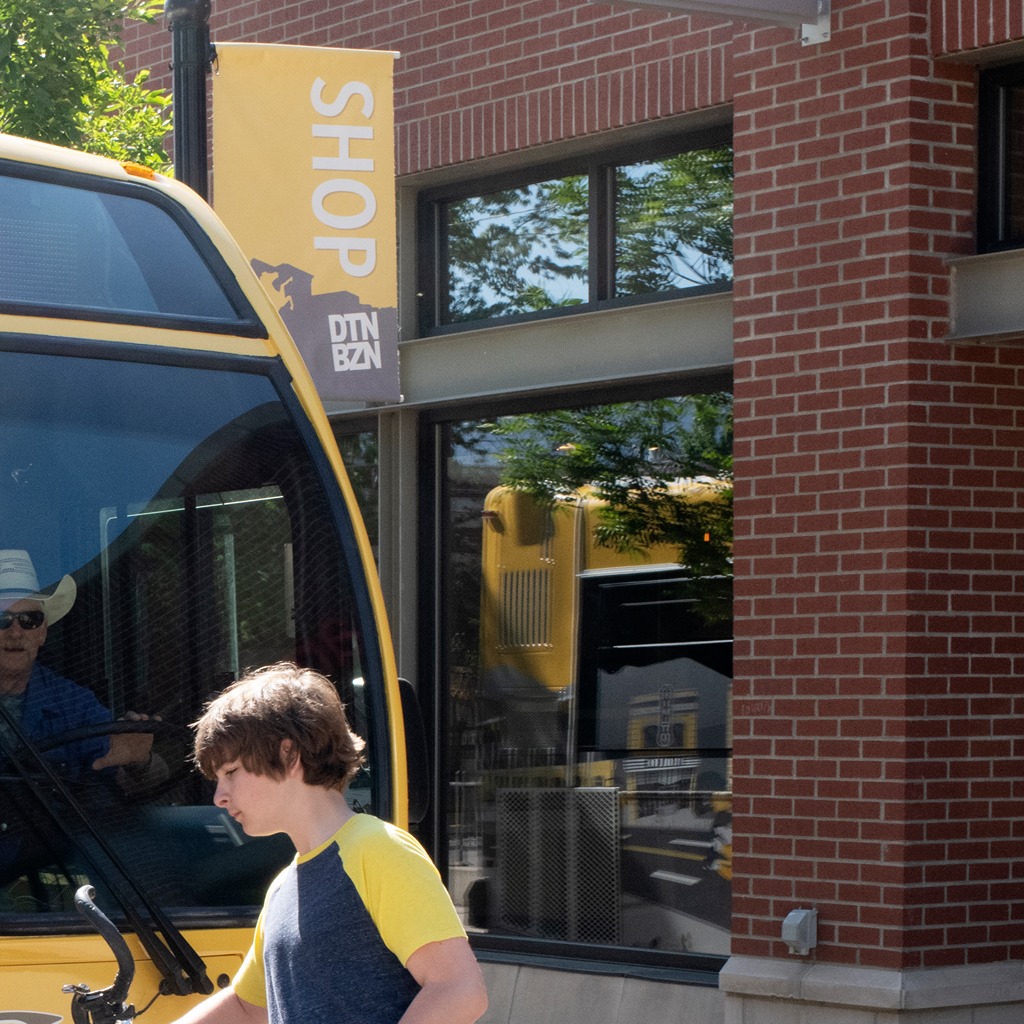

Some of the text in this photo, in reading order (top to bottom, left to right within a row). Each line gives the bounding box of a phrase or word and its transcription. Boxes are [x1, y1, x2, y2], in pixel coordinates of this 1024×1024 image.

[310, 76, 377, 277] SHOP
[328, 312, 379, 343] DTN
[332, 341, 382, 372] BZN
